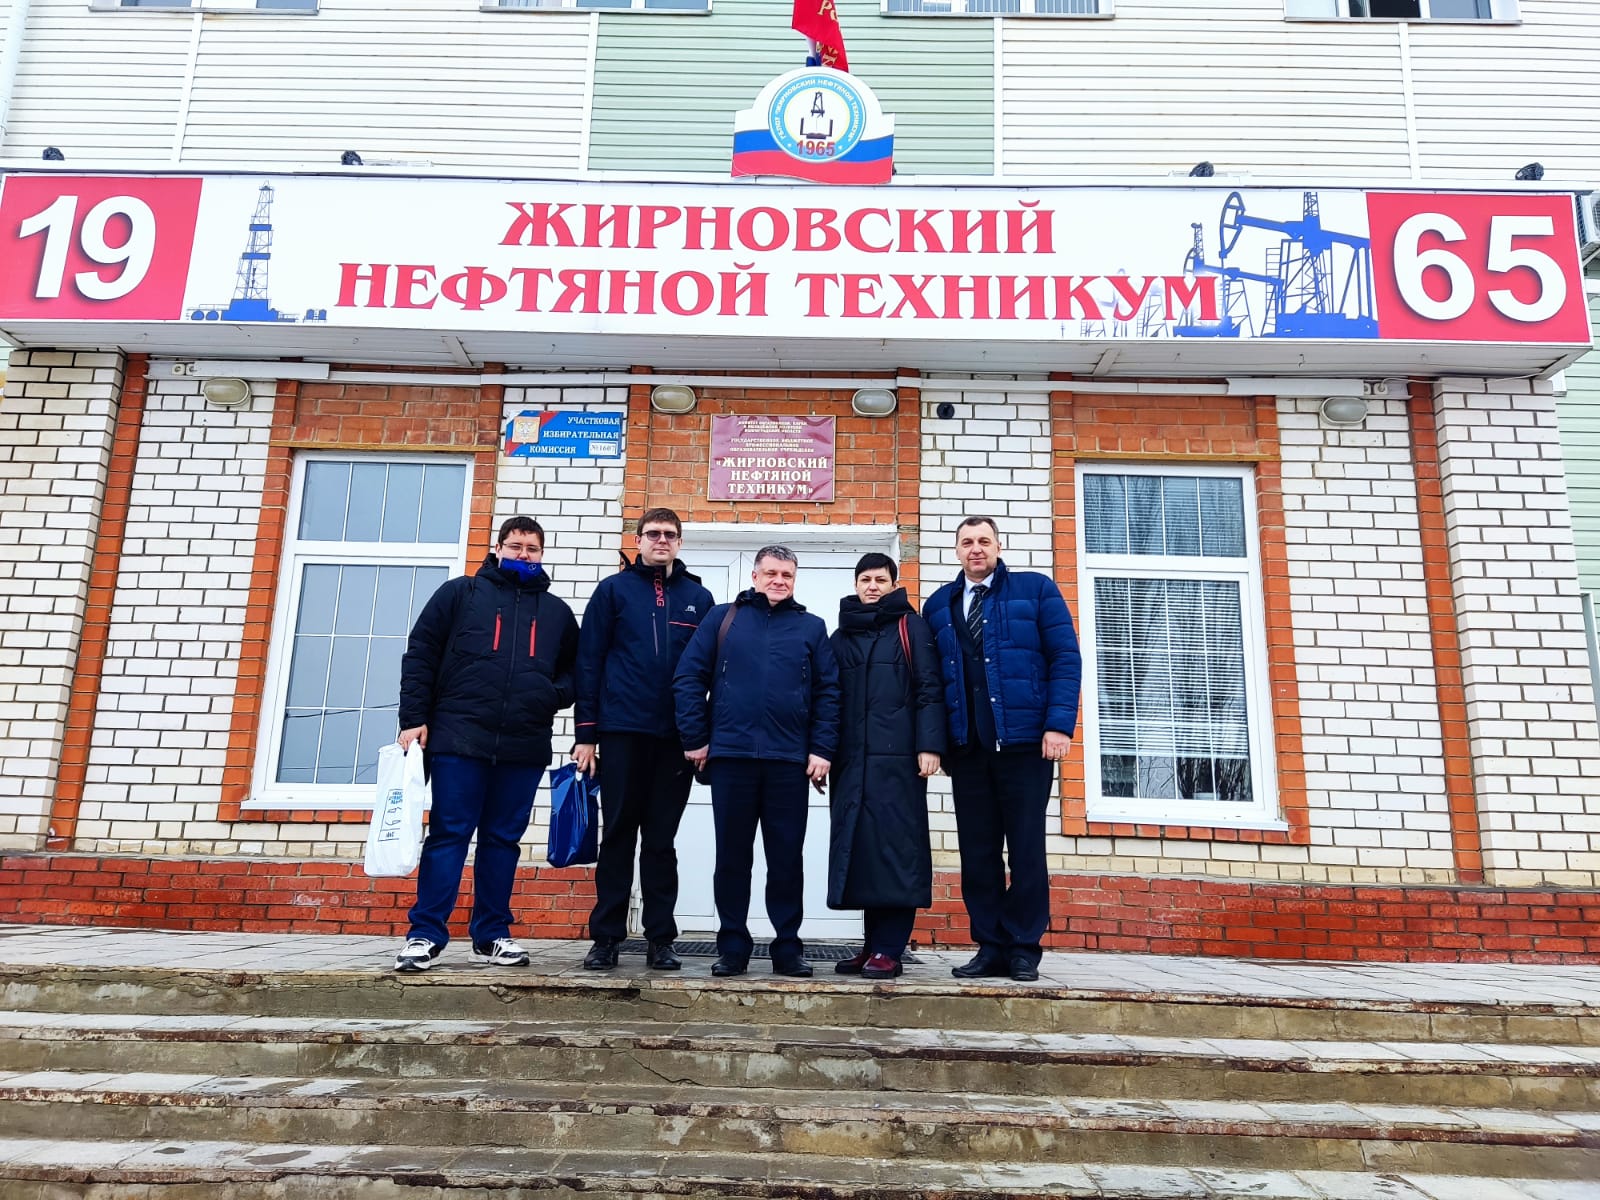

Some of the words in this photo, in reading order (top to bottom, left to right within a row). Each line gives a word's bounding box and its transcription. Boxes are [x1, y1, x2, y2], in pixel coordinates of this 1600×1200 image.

[797, 140, 836, 157] 1965
[497, 199, 1057, 254] ЖИРНОВСКИЙ
[19, 195, 156, 301] 19
[1393, 212, 1567, 322] 65
[334, 261, 771, 317] НЕФТЯНОЙ
[794, 272, 1222, 322] ТЕХНИКУМ
[567, 416, 620, 426] УЧАСТКОВАЯ
[543, 430, 620, 440] ИЗБИРАТЕЛЬНАЯ
[529, 445, 577, 455] КОМИССИЯ
[716, 456, 828, 469] «ЖИРНОВСКИЙ
[731, 470, 812, 482] НЕФТЯНОЙ
[727, 483, 814, 495] ТЕХНИКУМ»
